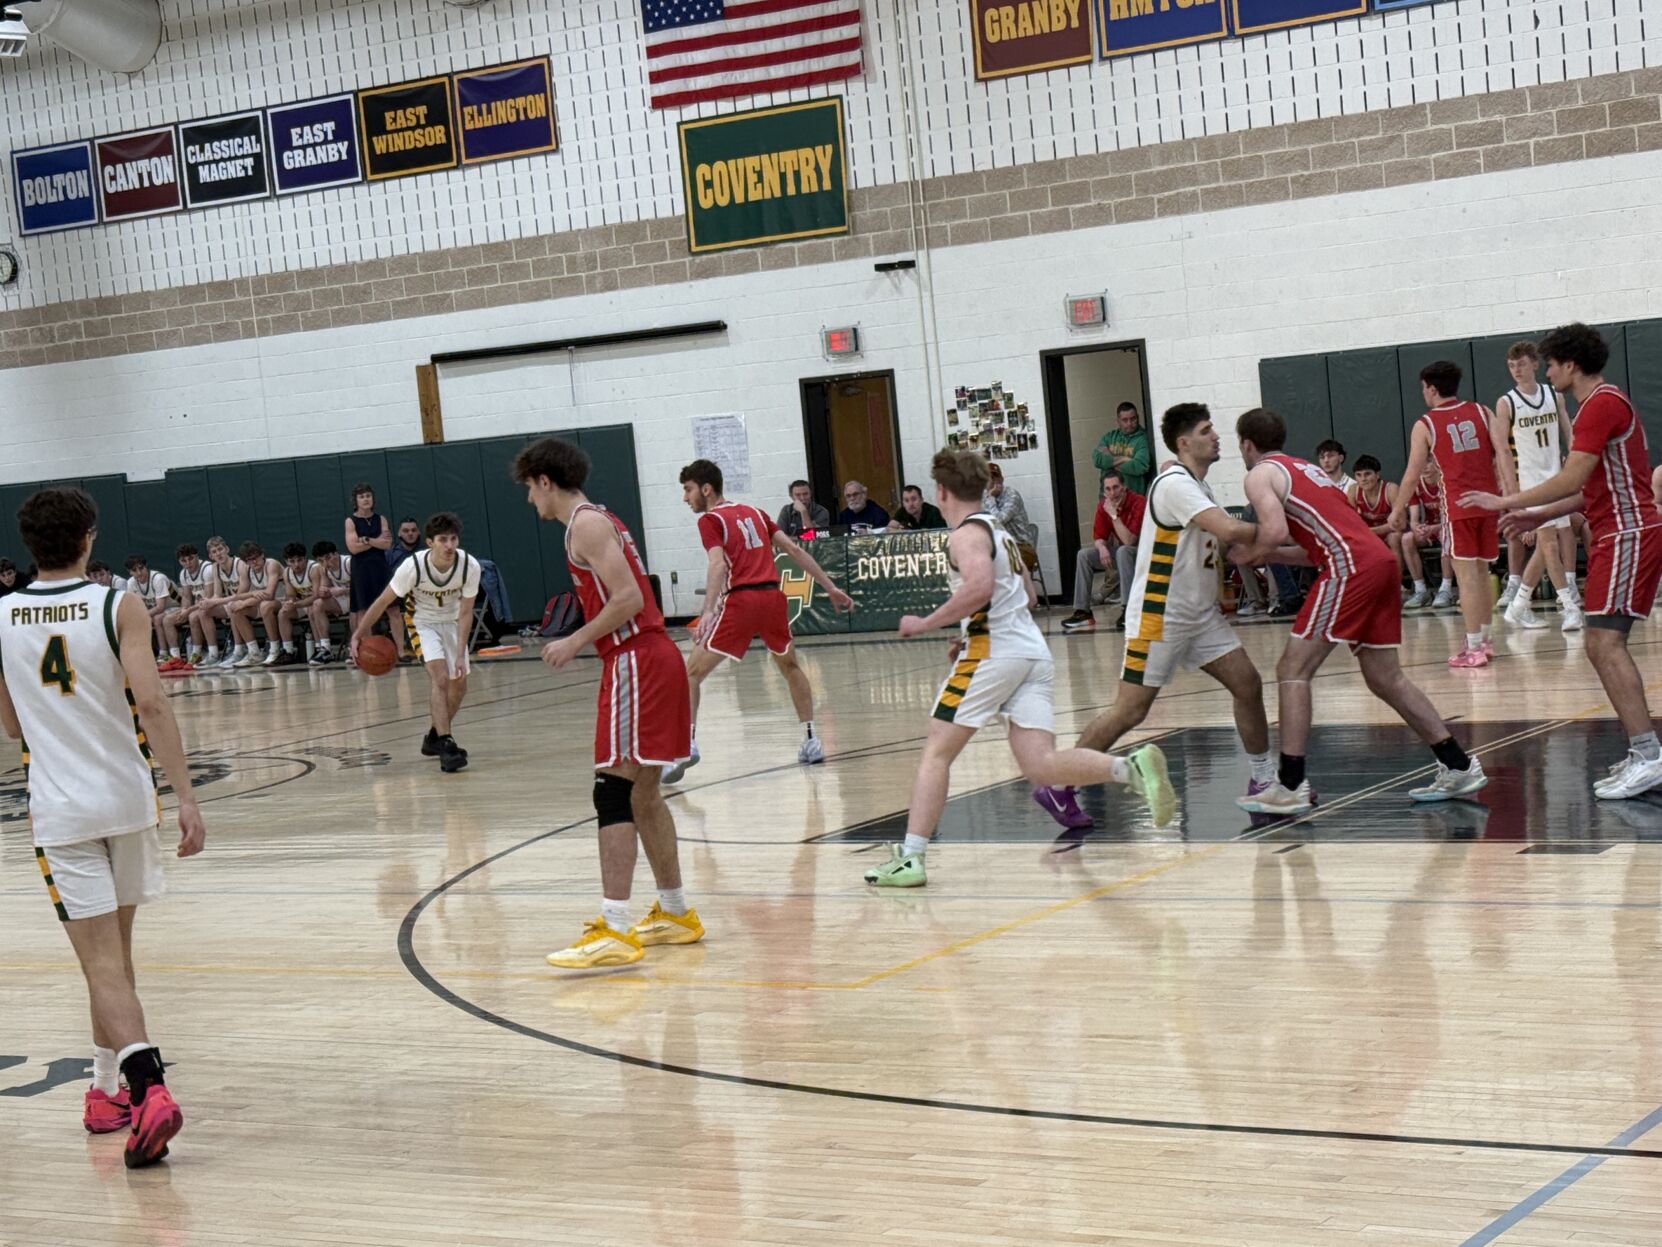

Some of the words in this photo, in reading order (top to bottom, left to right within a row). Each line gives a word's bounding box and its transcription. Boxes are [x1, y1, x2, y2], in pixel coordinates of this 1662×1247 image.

[984, 0, 1080, 43] GRANBY
[384, 105, 428, 130] EAST
[462, 94, 547, 130] ELLINGTON
[291, 121, 336, 146] EAST
[372, 125, 447, 155] WINDSOR
[186, 135, 261, 164] CLASSICAL
[283, 141, 349, 170] GRANBY
[104, 155, 175, 194] CANTON
[198, 159, 255, 183] MAGNET
[695, 144, 833, 209] COVENTRY
[22, 169, 89, 207] BOLTON
[1519, 412, 1558, 428] COVENTRY
[1446, 420, 1480, 453] 12
[1535, 428, 1549, 448] 11
[736, 517, 764, 550] 11
[857, 552, 948, 580] COVENTR
[11, 602, 89, 626] PATRIOTS
[39, 634, 76, 696] 4
